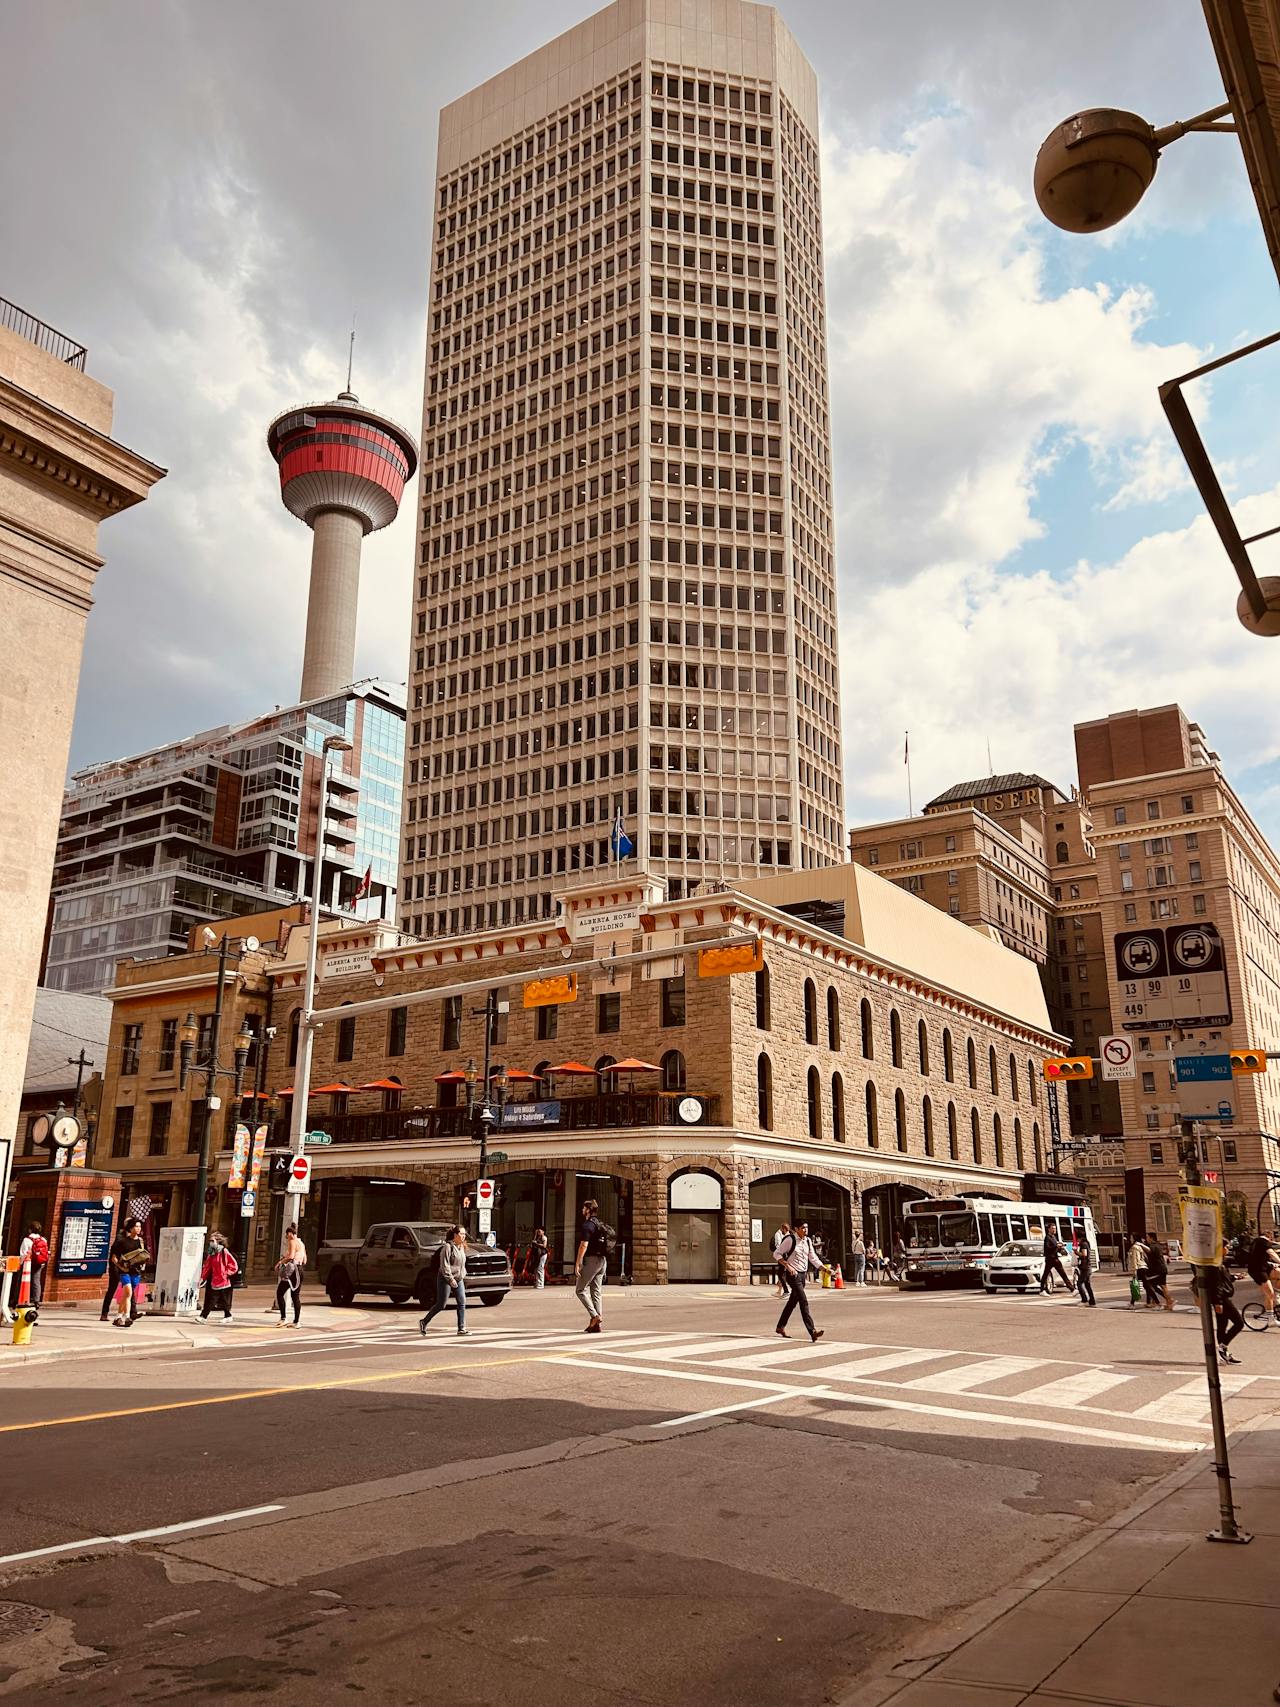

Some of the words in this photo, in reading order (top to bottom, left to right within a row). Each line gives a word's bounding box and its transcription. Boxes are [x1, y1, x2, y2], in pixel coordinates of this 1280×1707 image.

[580, 917, 609, 926] ALBERTA
[614, 912, 636, 920] HOTEL
[591, 922, 624, 932] BUILDING
[1125, 983, 1136, 994] 13
[1149, 980, 1160, 991] 90
[1179, 978, 1190, 990] 10
[1125, 1004, 1143, 1015] 449
[1180, 1068, 1195, 1076] 901
[1211, 1066, 1228, 1074] 902
